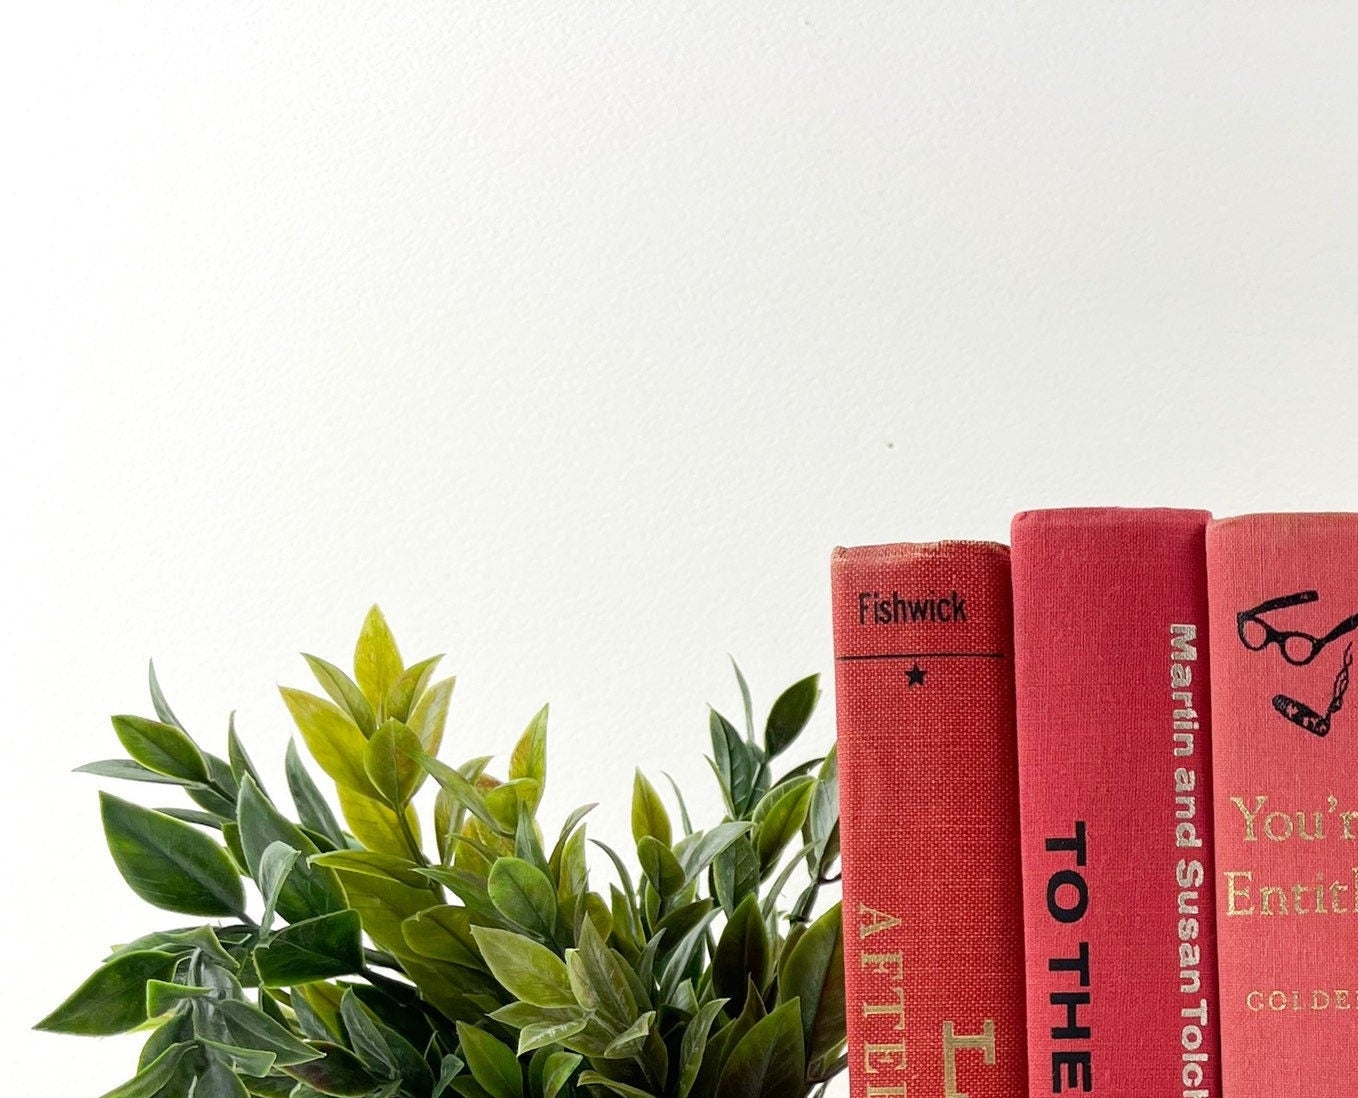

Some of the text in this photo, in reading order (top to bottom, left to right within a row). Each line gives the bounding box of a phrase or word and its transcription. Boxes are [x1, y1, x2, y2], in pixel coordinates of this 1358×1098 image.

[858, 591, 967, 624] Fishwick
[1170, 624, 1198, 757] Martin
[1174, 767, 1201, 848] and
[1044, 821, 1088, 924] TO
[1175, 860, 1204, 993] Susan
[1047, 942, 1093, 1095] THE
